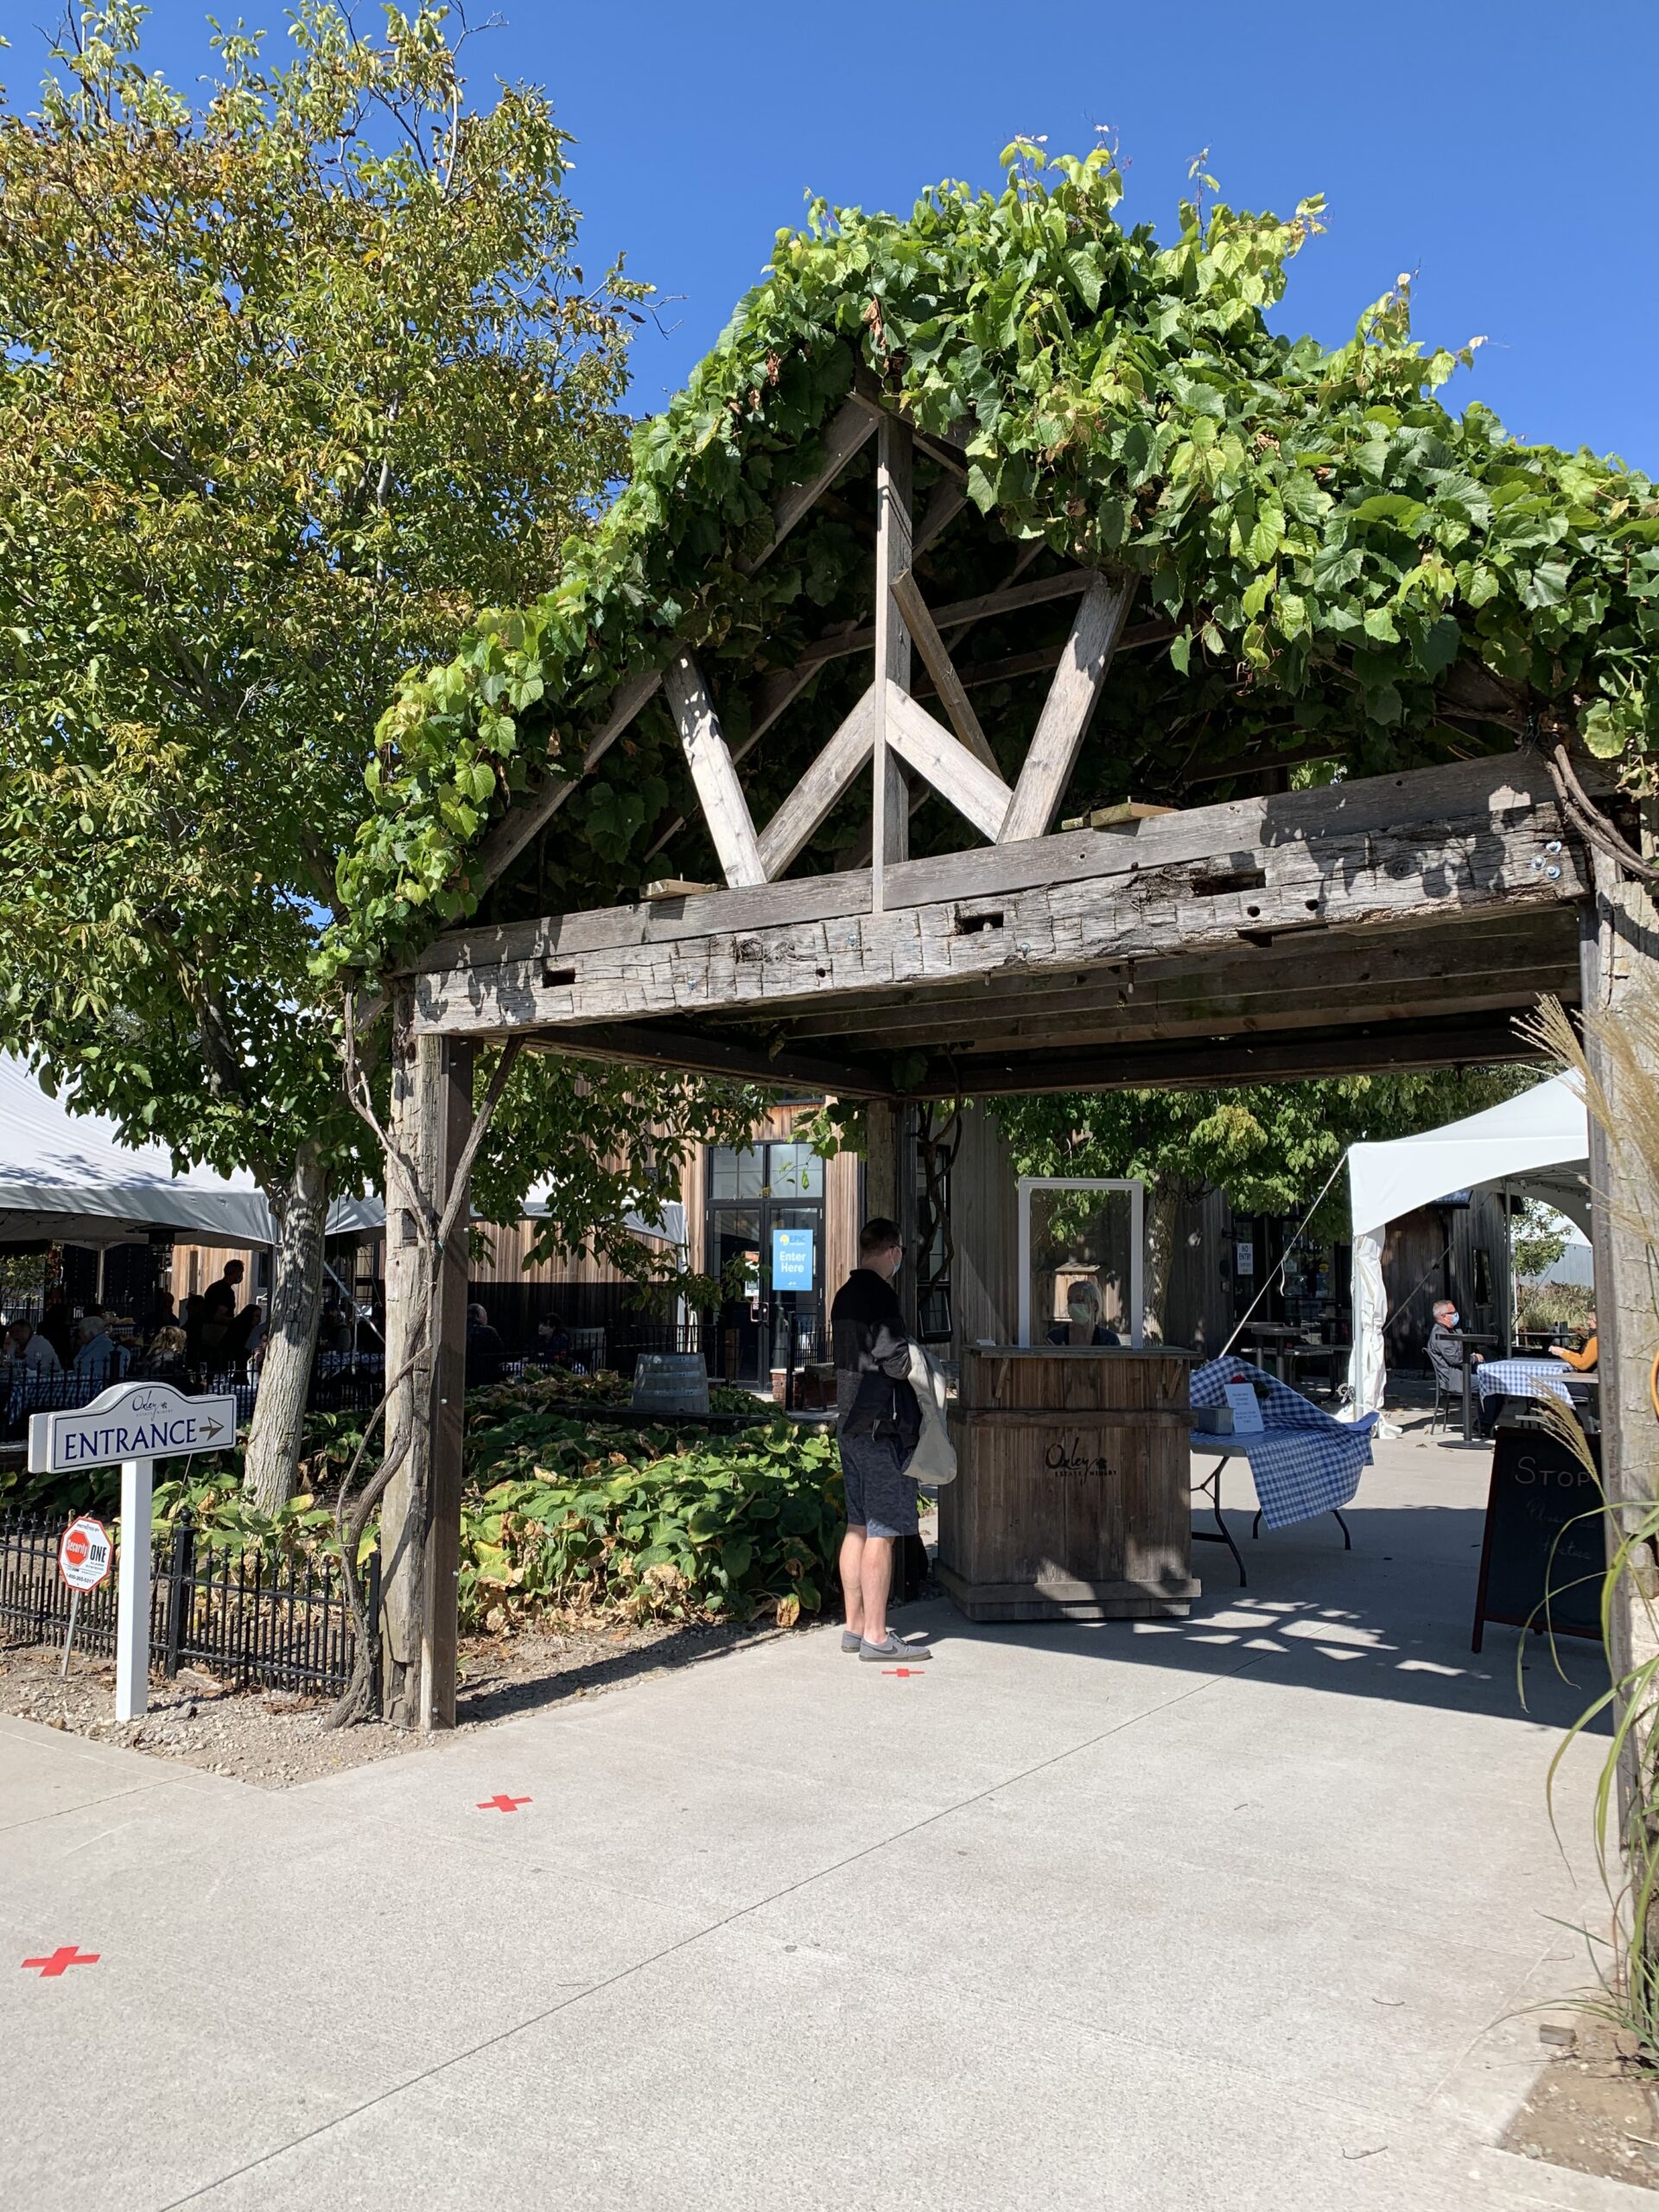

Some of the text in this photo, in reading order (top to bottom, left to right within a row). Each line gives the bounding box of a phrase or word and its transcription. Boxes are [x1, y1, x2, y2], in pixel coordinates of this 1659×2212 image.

[779, 1250, 806, 1262] Enter
[781, 1262, 804, 1273] Here
[132, 1389, 161, 1421] Oxley
[65, 1418, 197, 1460] ENTRANCE
[1046, 1437, 1099, 1486] Oxley
[67, 1538, 88, 1557] Security
[90, 1544, 107, 1563] ONE
